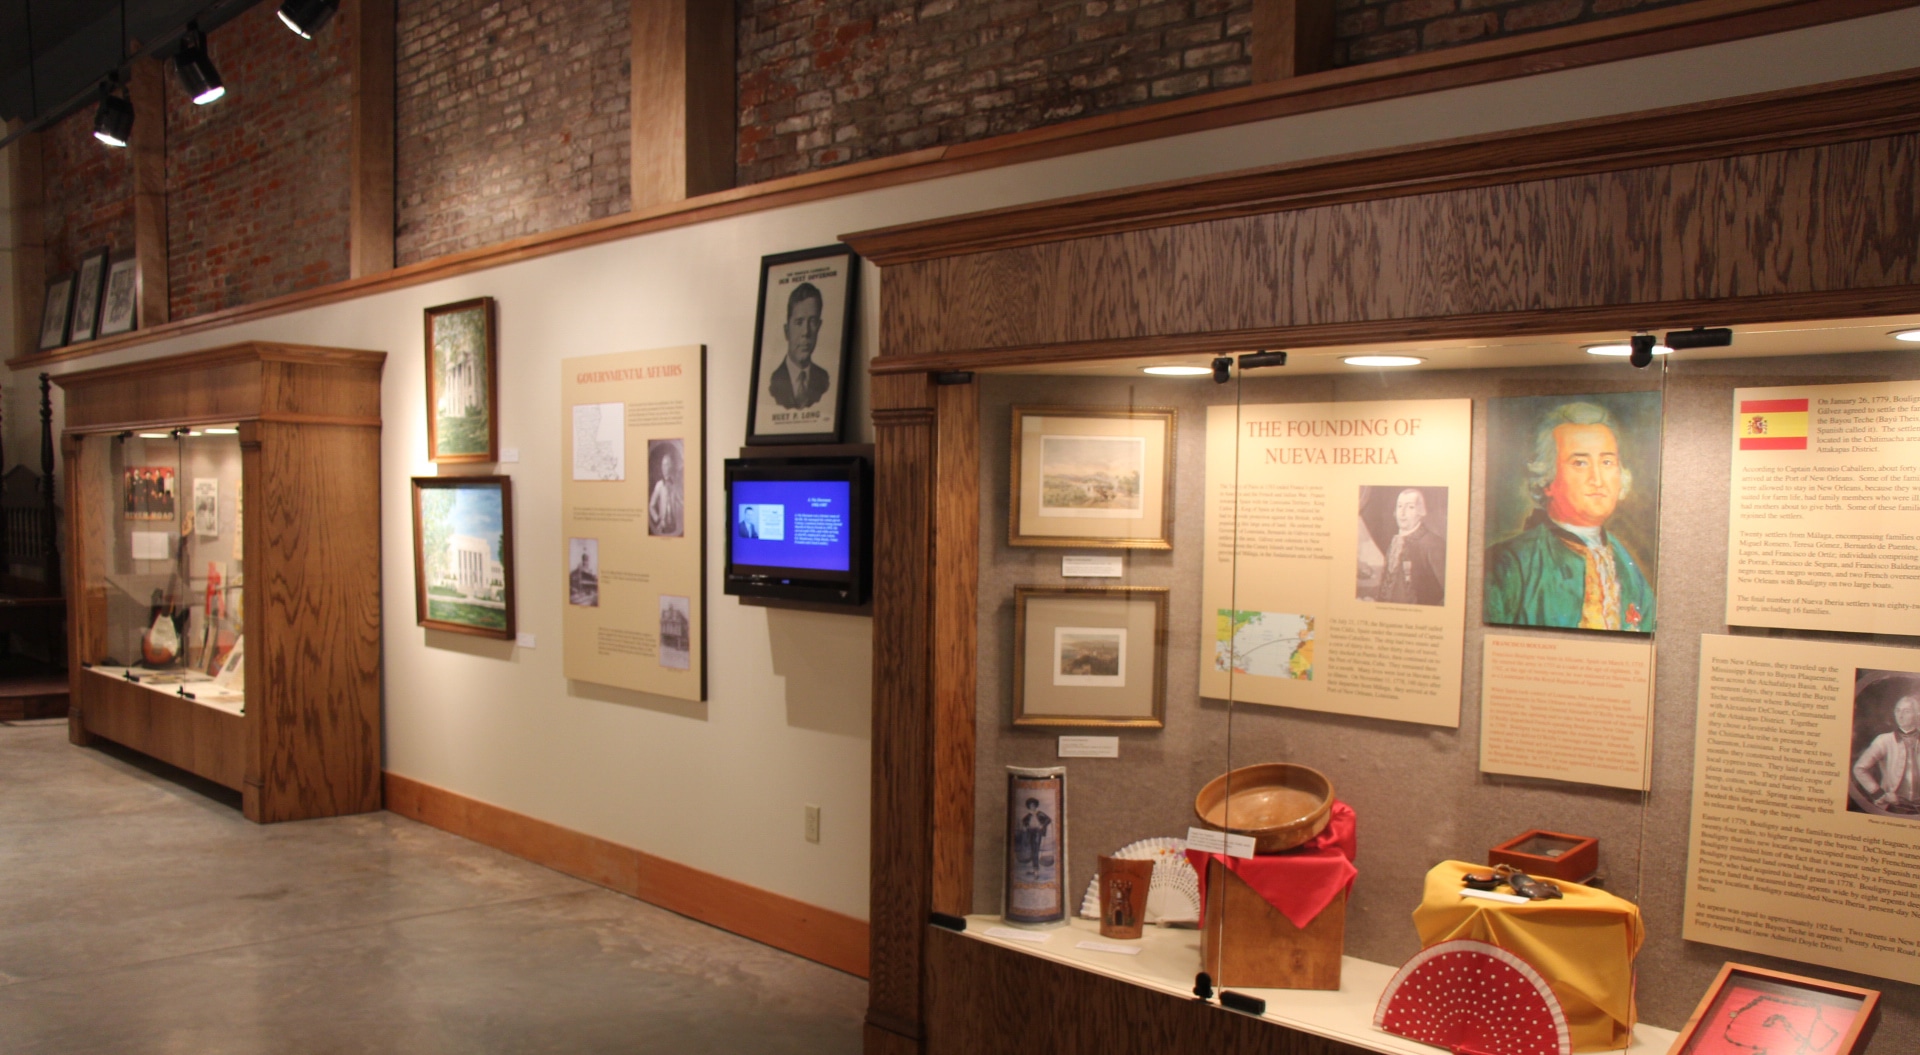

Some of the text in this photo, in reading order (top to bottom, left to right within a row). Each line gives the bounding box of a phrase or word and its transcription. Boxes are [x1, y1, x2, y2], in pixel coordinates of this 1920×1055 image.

[577, 368, 643, 384] GOVERNMENTAL
[1844, 406, 1865, 416] agreed
[1830, 417, 1851, 426] Bayou
[1246, 418, 1422, 437] THE FOUNDING OF
[1817, 426, 1843, 436] Spanish
[1265, 448, 1398, 464] NUEVA IBERIA
[1785, 466, 1810, 474] Captain
[1854, 581, 1871, 590] large
[1735, 925, 1751, 934] Road
[1849, 928, 1863, 936] Two
[1865, 932, 1887, 940] streets
[1898, 937, 1914, 945] New
[1845, 936, 1869, 949] Twenty
[1872, 942, 1895, 952] Arpent
[1897, 947, 1915, 956] Road
